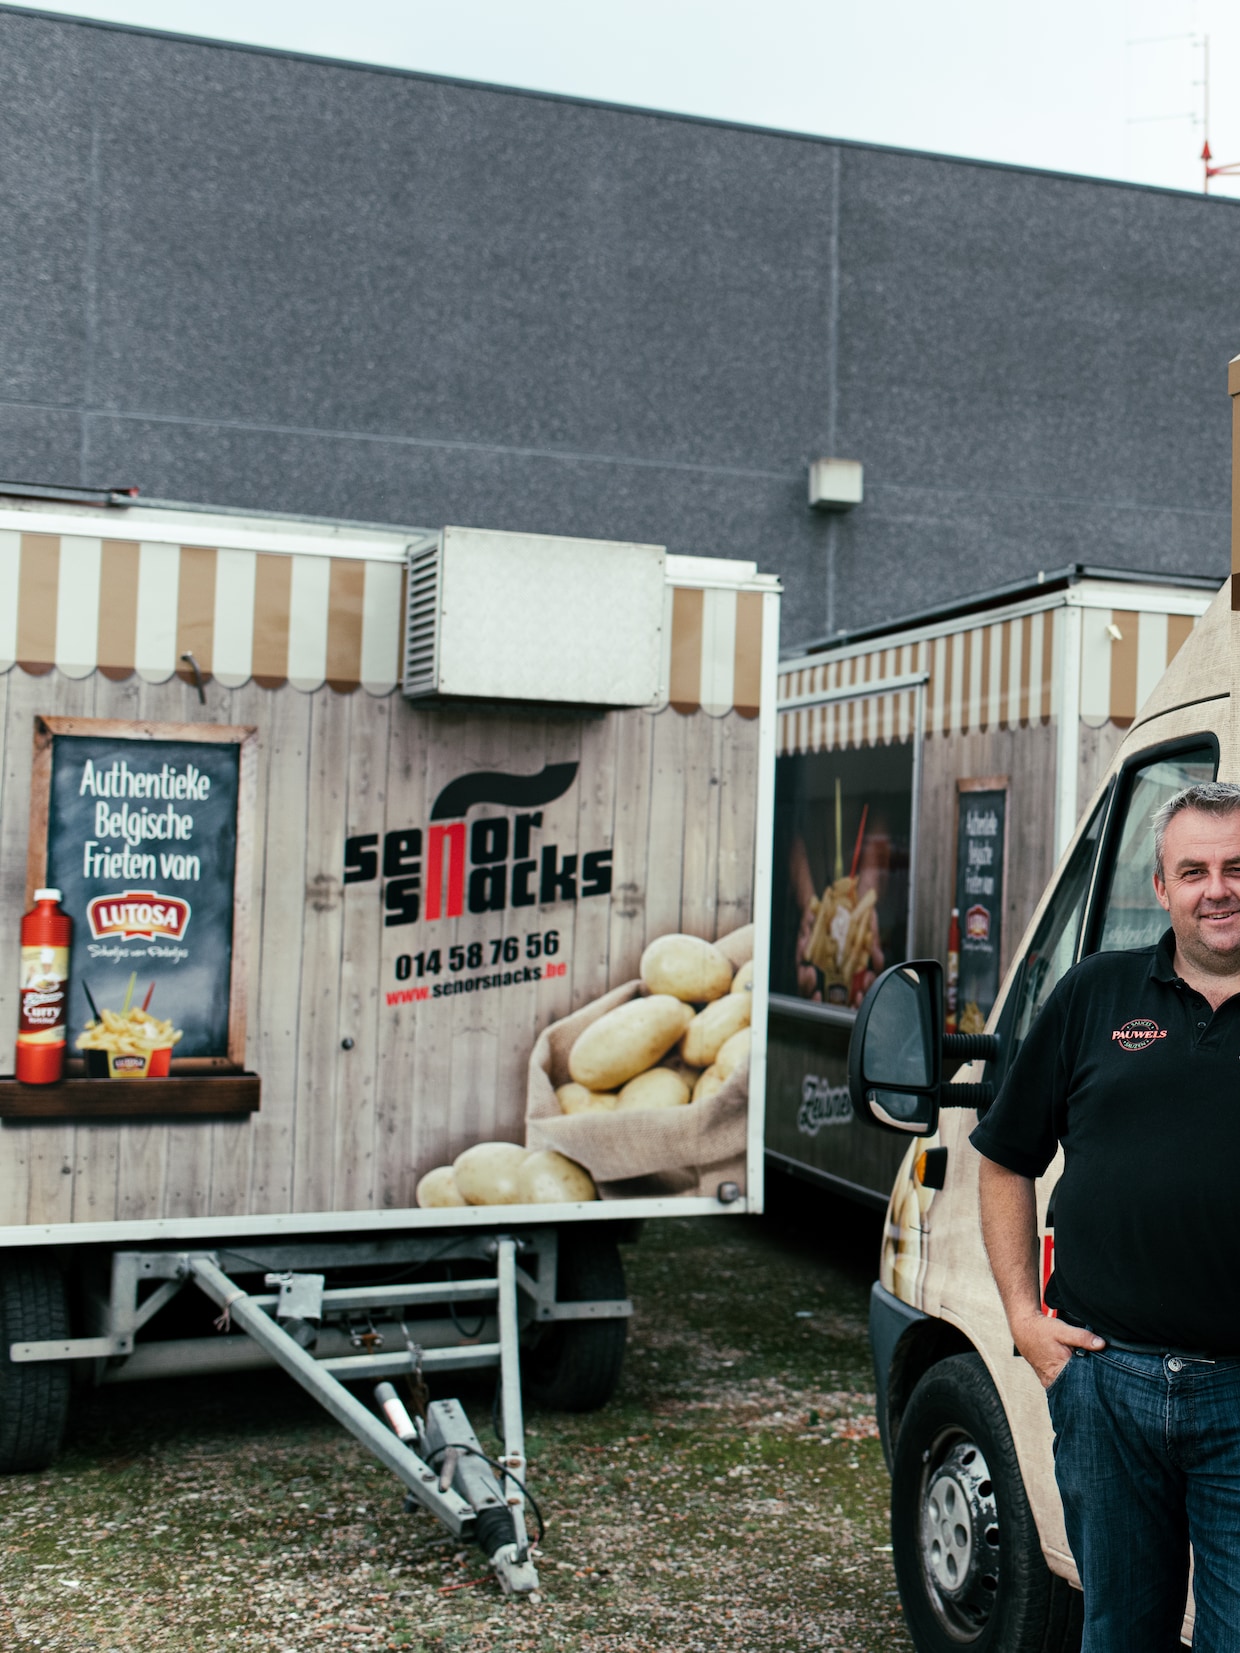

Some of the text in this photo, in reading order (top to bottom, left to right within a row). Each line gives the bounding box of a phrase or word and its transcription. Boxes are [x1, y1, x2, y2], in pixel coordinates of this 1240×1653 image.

[79, 759, 211, 801] Authentieke
[95, 801, 193, 846] Belgische
[83, 841, 201, 881] Frieten van
[99, 903, 179, 929] LUTOSA
[395, 930, 560, 981] 014 58 76 56
[386, 961, 567, 1006] www.senorsnacks.be
[1111, 1030, 1168, 1040] PAUWELS
